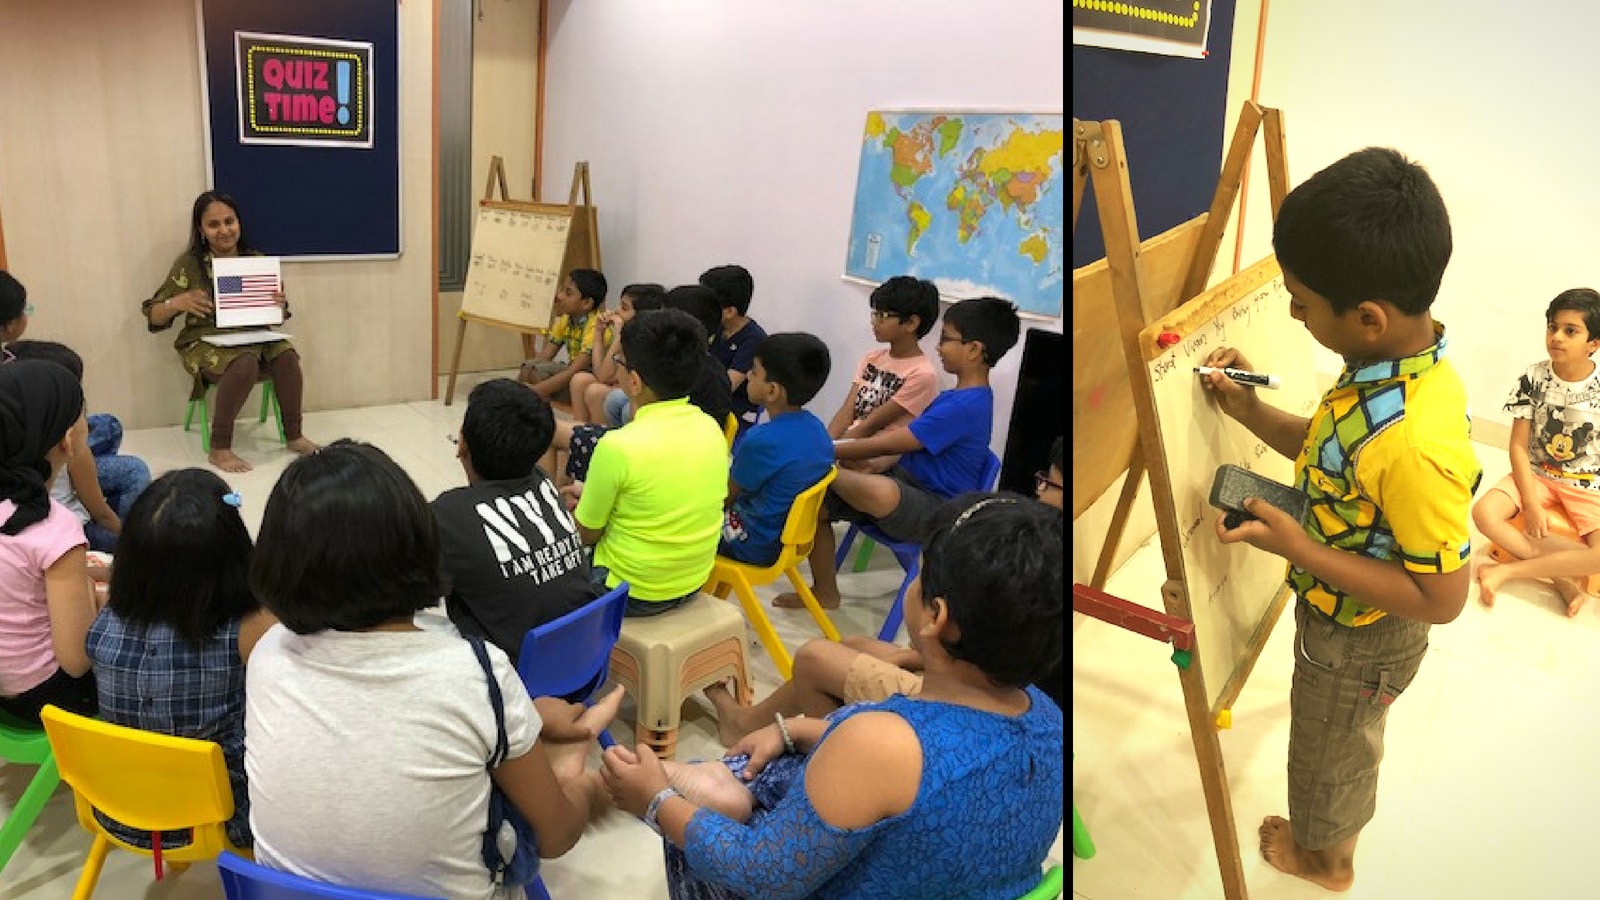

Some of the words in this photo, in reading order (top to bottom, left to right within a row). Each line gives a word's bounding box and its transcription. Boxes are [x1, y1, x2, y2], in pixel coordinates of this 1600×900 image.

[263, 58, 328, 90] QUIZ
[500, 564, 509, 579] I
[512, 554, 535, 576] AM
[534, 538, 572, 566] READY
[529, 559, 565, 585] TAKE
